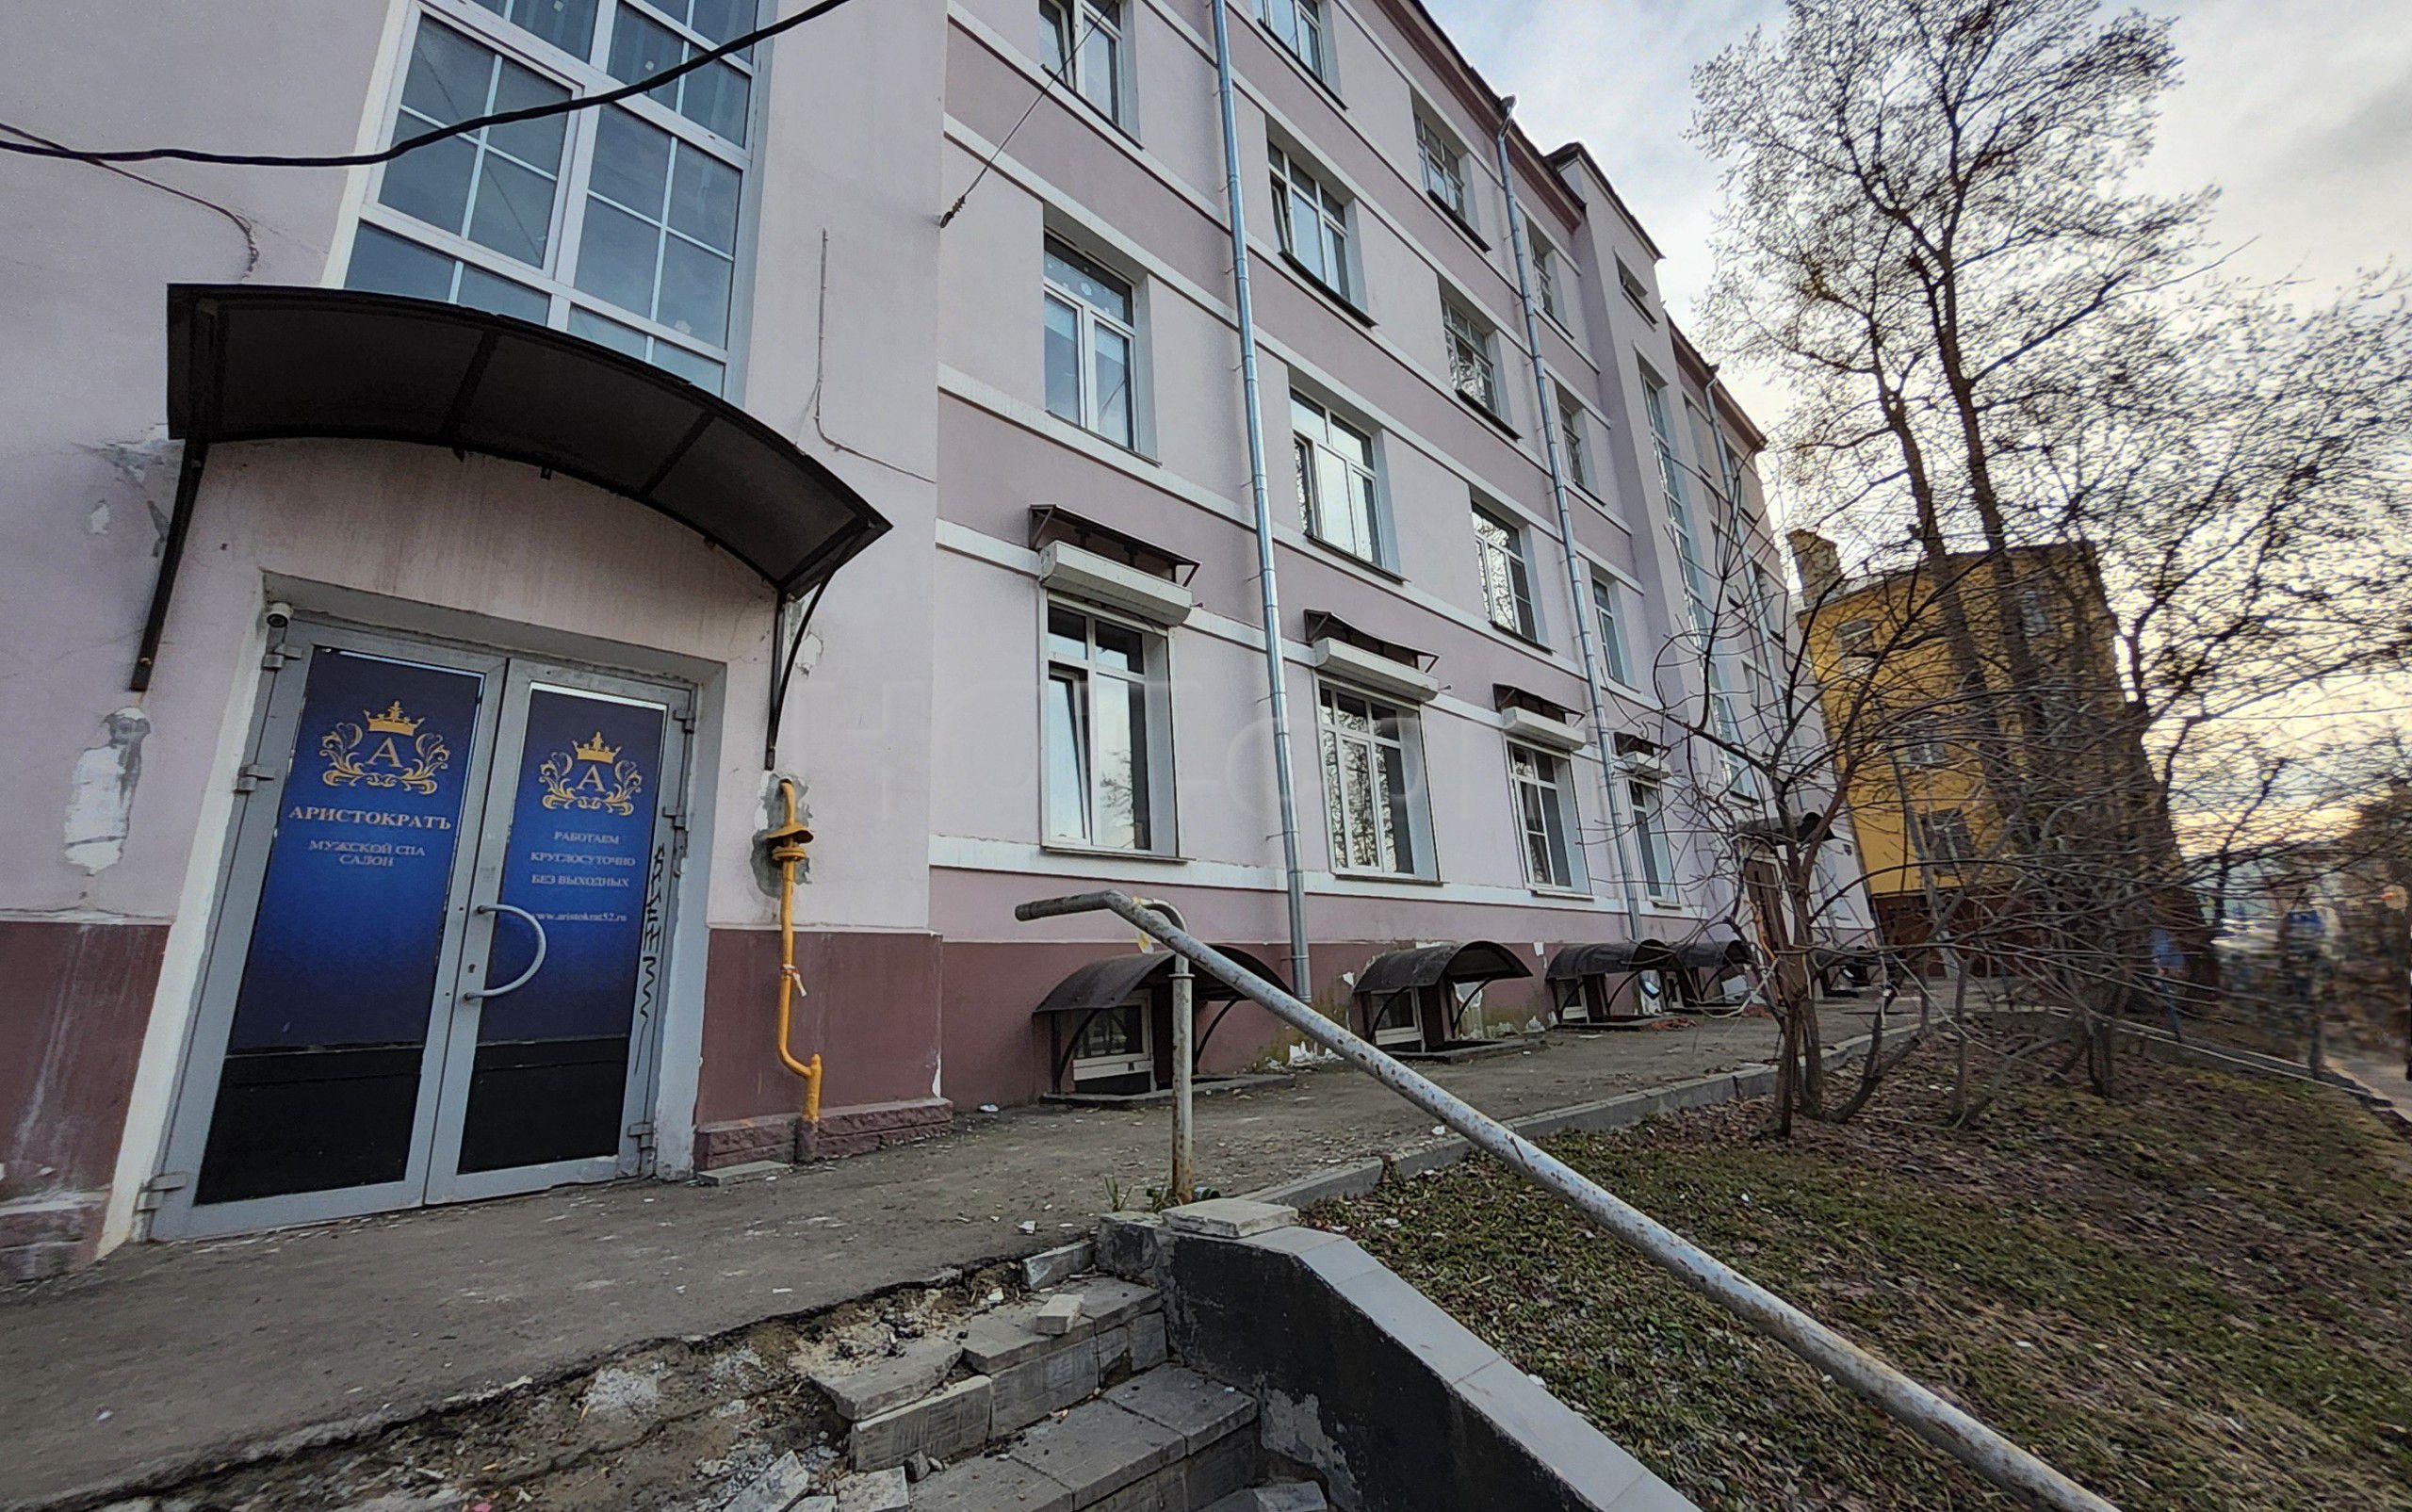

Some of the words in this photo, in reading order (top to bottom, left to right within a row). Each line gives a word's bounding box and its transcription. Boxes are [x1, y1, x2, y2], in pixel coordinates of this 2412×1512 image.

[288, 805, 451, 830] АРИСТОКРАТЪ
[554, 831, 620, 844] РАБОТАЕМ
[308, 840, 392, 854] МУЖСКОЙ
[396, 845, 425, 856] СПА
[339, 854, 394, 867] САЛОН
[530, 852, 636, 866] КРУГЛОСУТОЧНО
[531, 874, 556, 885] БЕЗ
[558, 875, 629, 887] ВЫХОДНЫХ
